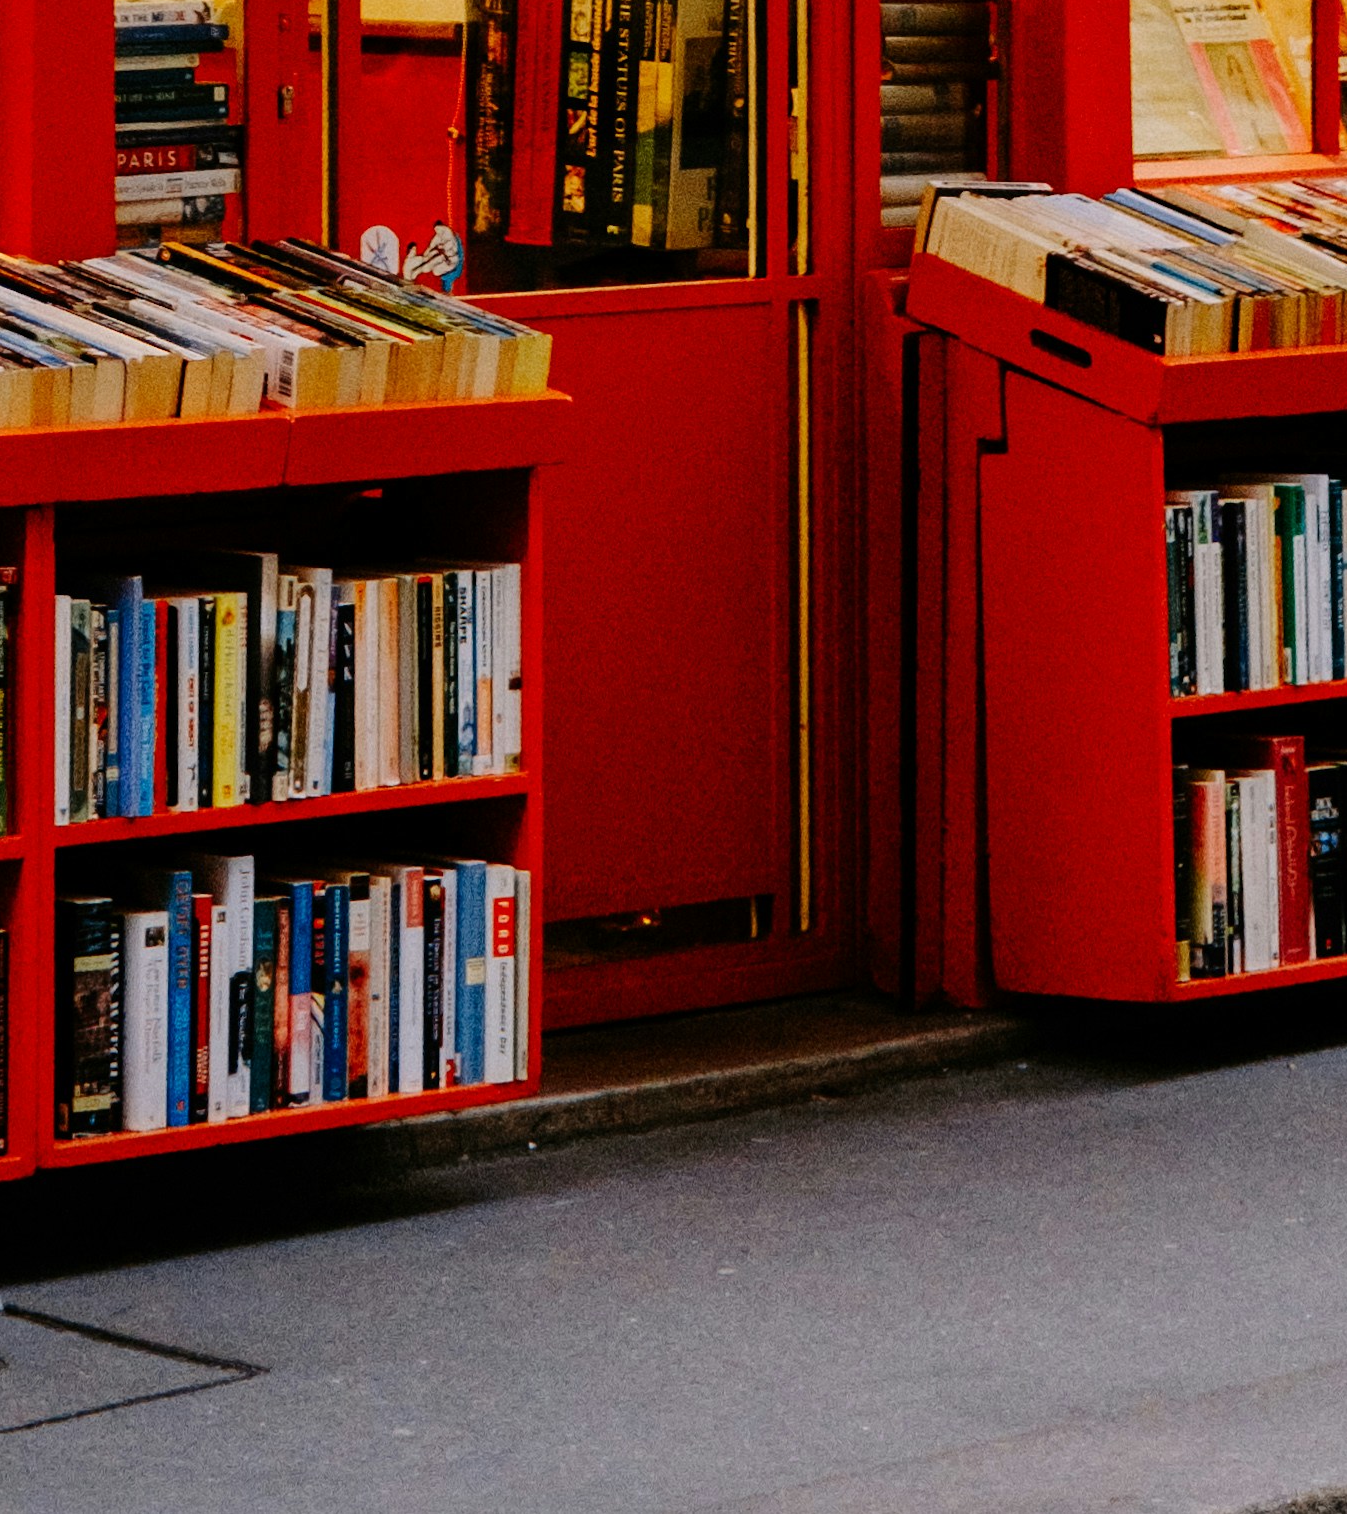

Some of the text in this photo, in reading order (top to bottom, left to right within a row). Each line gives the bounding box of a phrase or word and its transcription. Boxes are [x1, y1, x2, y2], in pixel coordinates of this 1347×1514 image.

[588, 51, 601, 93] bande
[614, 27, 631, 113] STATUES
[613, 117, 627, 141] OF
[116, 149, 178, 168] PARIS
[611, 149, 626, 204] PARIS
[459, 586, 468, 644] SHARPE
[238, 868, 250, 968] John Grisham
[497, 900, 510, 955] FORD
[498, 961, 508, 1033] Independence
